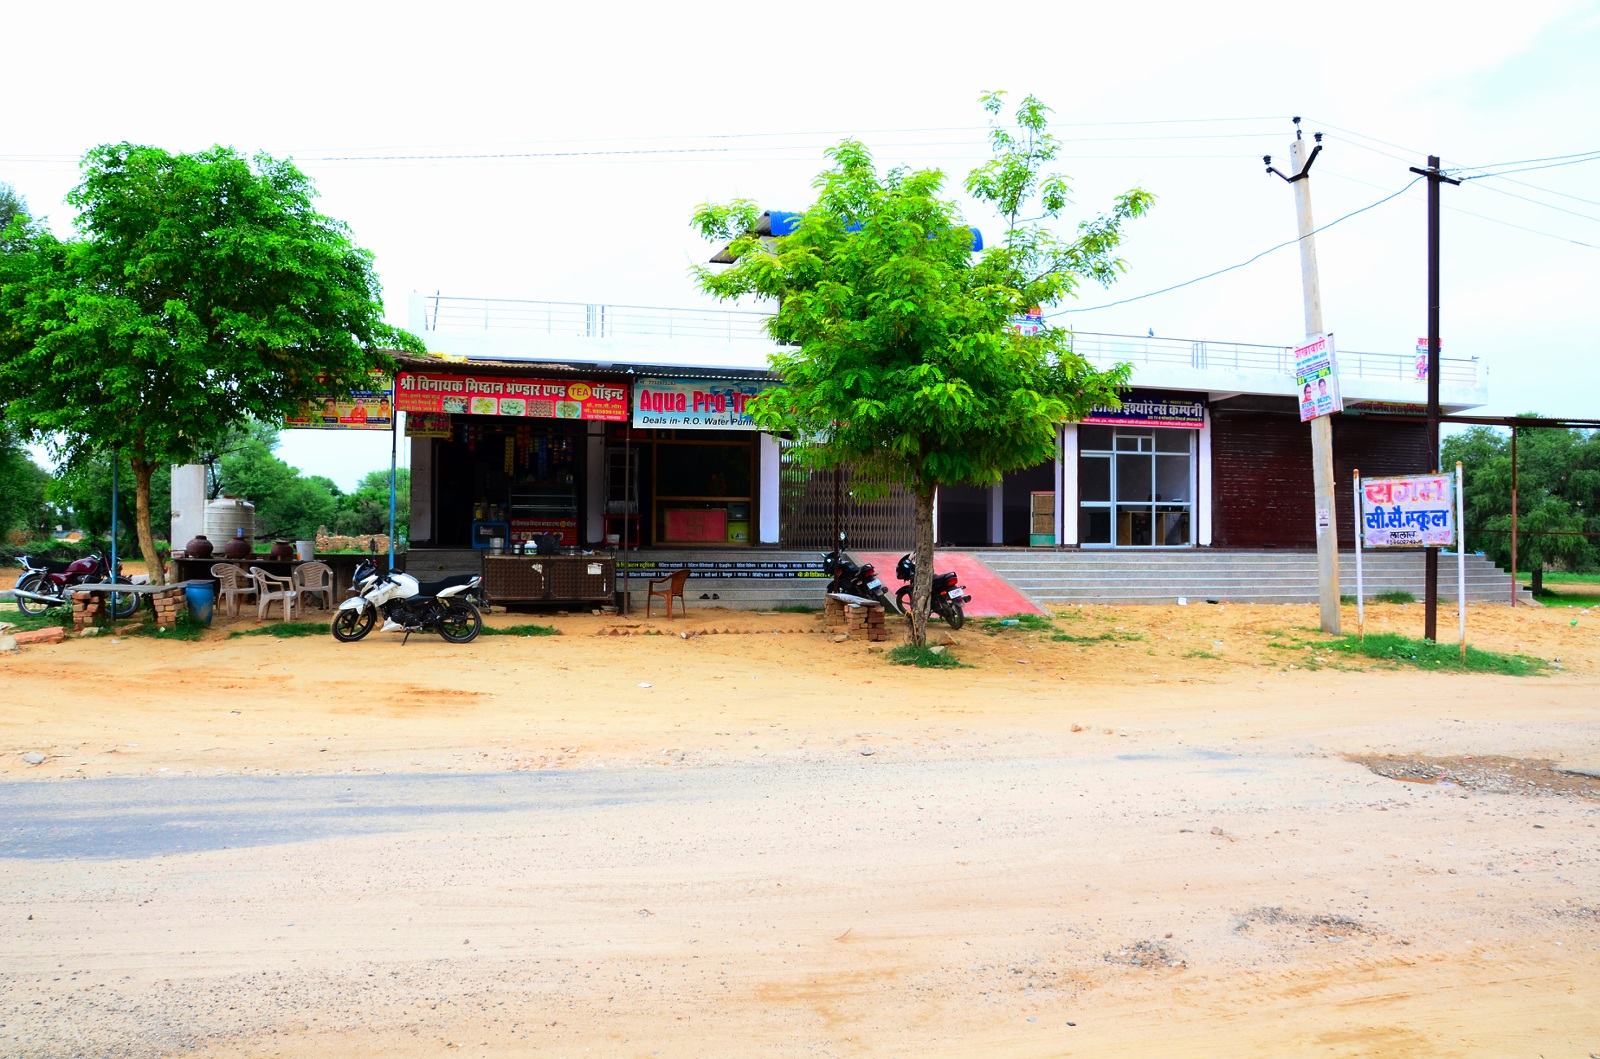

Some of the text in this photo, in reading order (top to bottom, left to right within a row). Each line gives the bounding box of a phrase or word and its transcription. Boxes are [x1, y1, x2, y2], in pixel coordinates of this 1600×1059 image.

[400, 375, 416, 391] श्री
[417, 376, 463, 392] विनायक
[570, 388, 589, 397] TEA
[640, 390, 687, 414] Aqua
[693, 391, 726, 413] Pro
[1123, 399, 1167, 415] इंश्योरेन्स
[1169, 403, 1202, 417] कम्पनी
[642, 416, 667, 425] Deals
[669, 417, 681, 425] in-
[704, 418, 730, 426] Water
[1365, 478, 1447, 504] संगम
